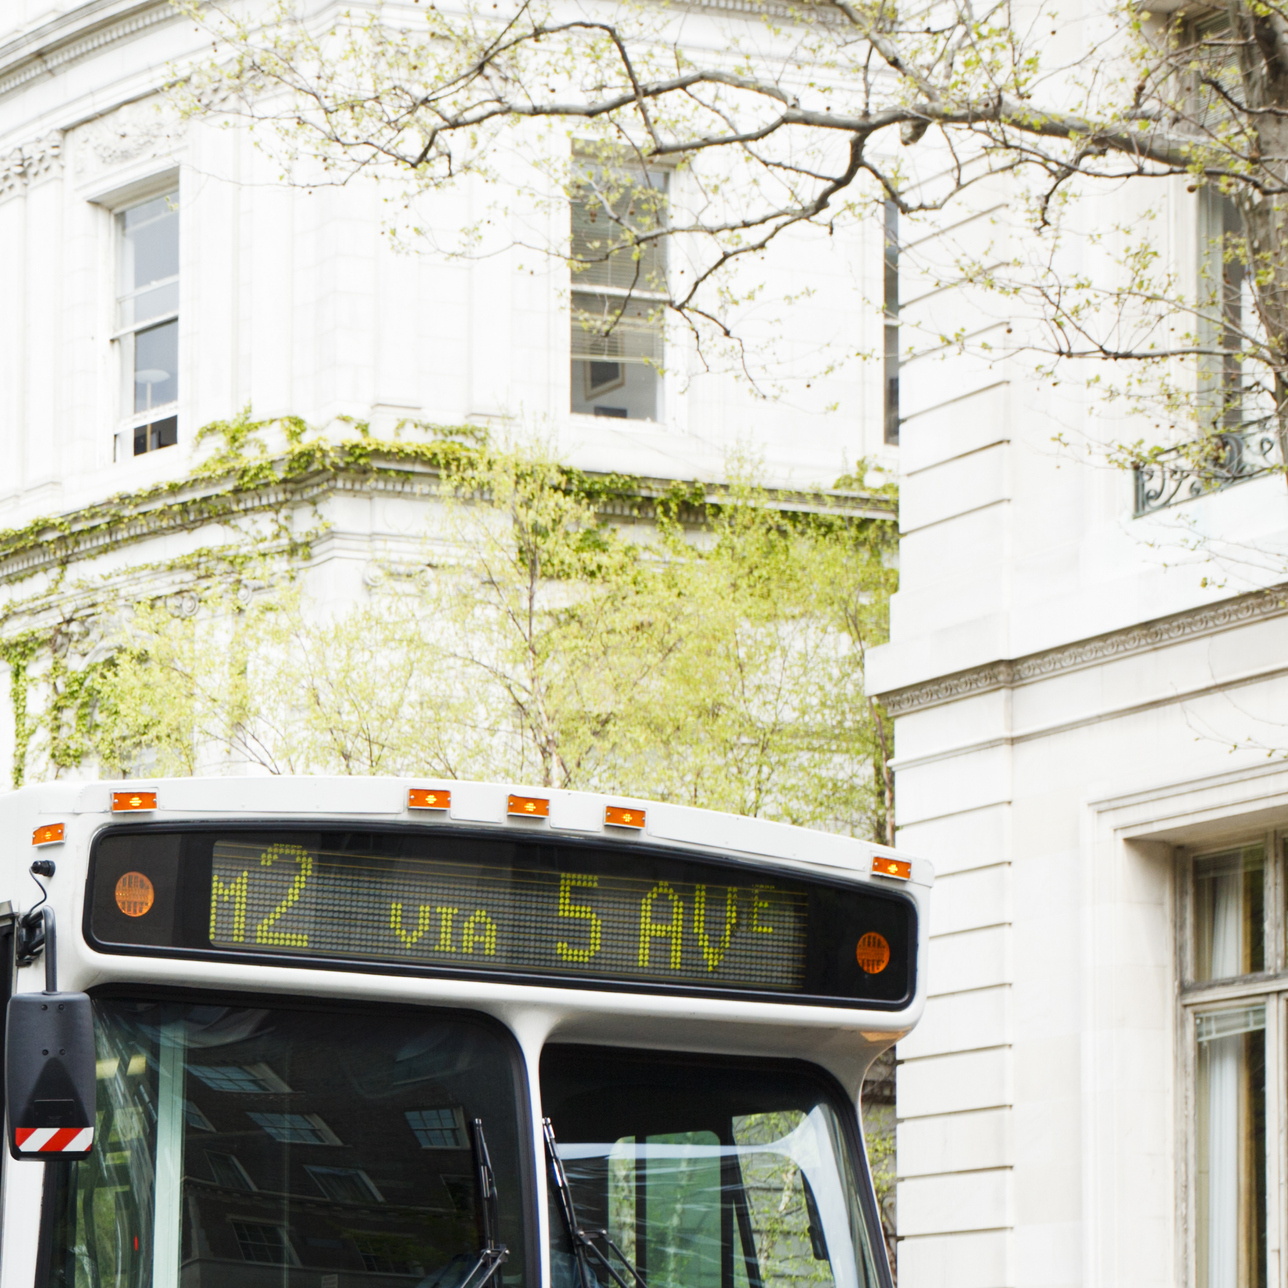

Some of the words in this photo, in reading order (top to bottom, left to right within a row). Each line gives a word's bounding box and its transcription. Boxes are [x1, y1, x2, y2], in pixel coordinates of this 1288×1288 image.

[208, 842, 313, 949] M2
[390, 900, 499, 957] VIA
[556, 871, 602, 963] 5
